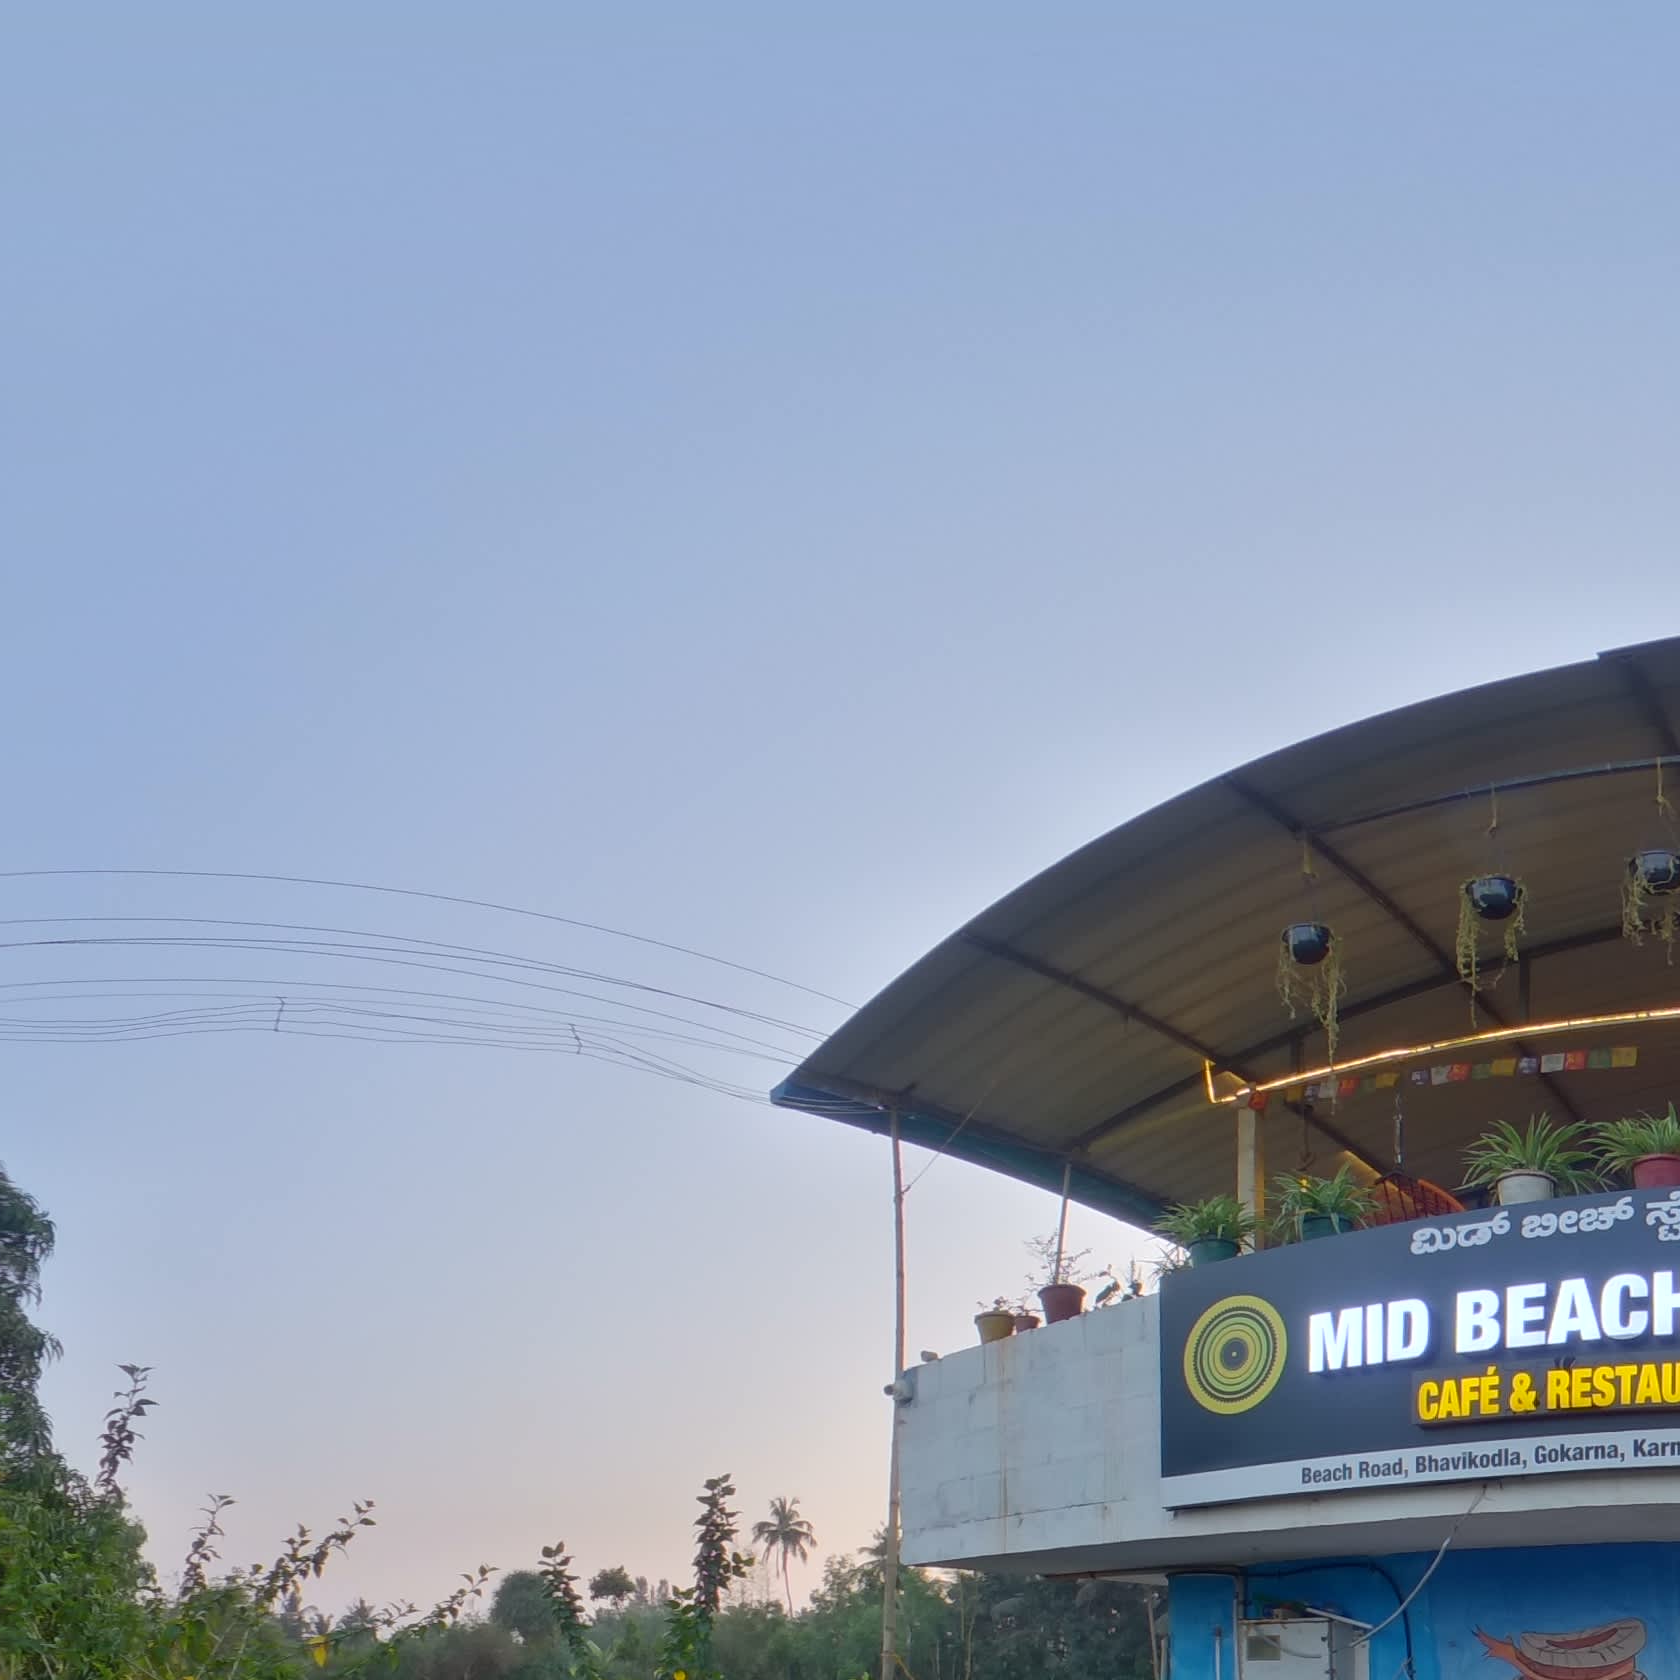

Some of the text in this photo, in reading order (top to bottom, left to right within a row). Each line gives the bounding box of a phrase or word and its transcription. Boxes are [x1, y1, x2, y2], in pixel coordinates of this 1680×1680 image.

[1410, 1210, 1511, 1255] ಮಿಡ್
[1520, 1196, 1635, 1239] ಬೀಚ್
[1307, 1298, 1430, 1373] MID
[1417, 1365, 1499, 1421] CAFÉ
[1509, 1372, 1537, 1415] &
[1301, 1463, 1353, 1484] Beach
[1358, 1457, 1409, 1478] Road,
[1415, 1448, 1528, 1475] Bhavikodla,
[1534, 1443, 1625, 1465] Gokarna,
